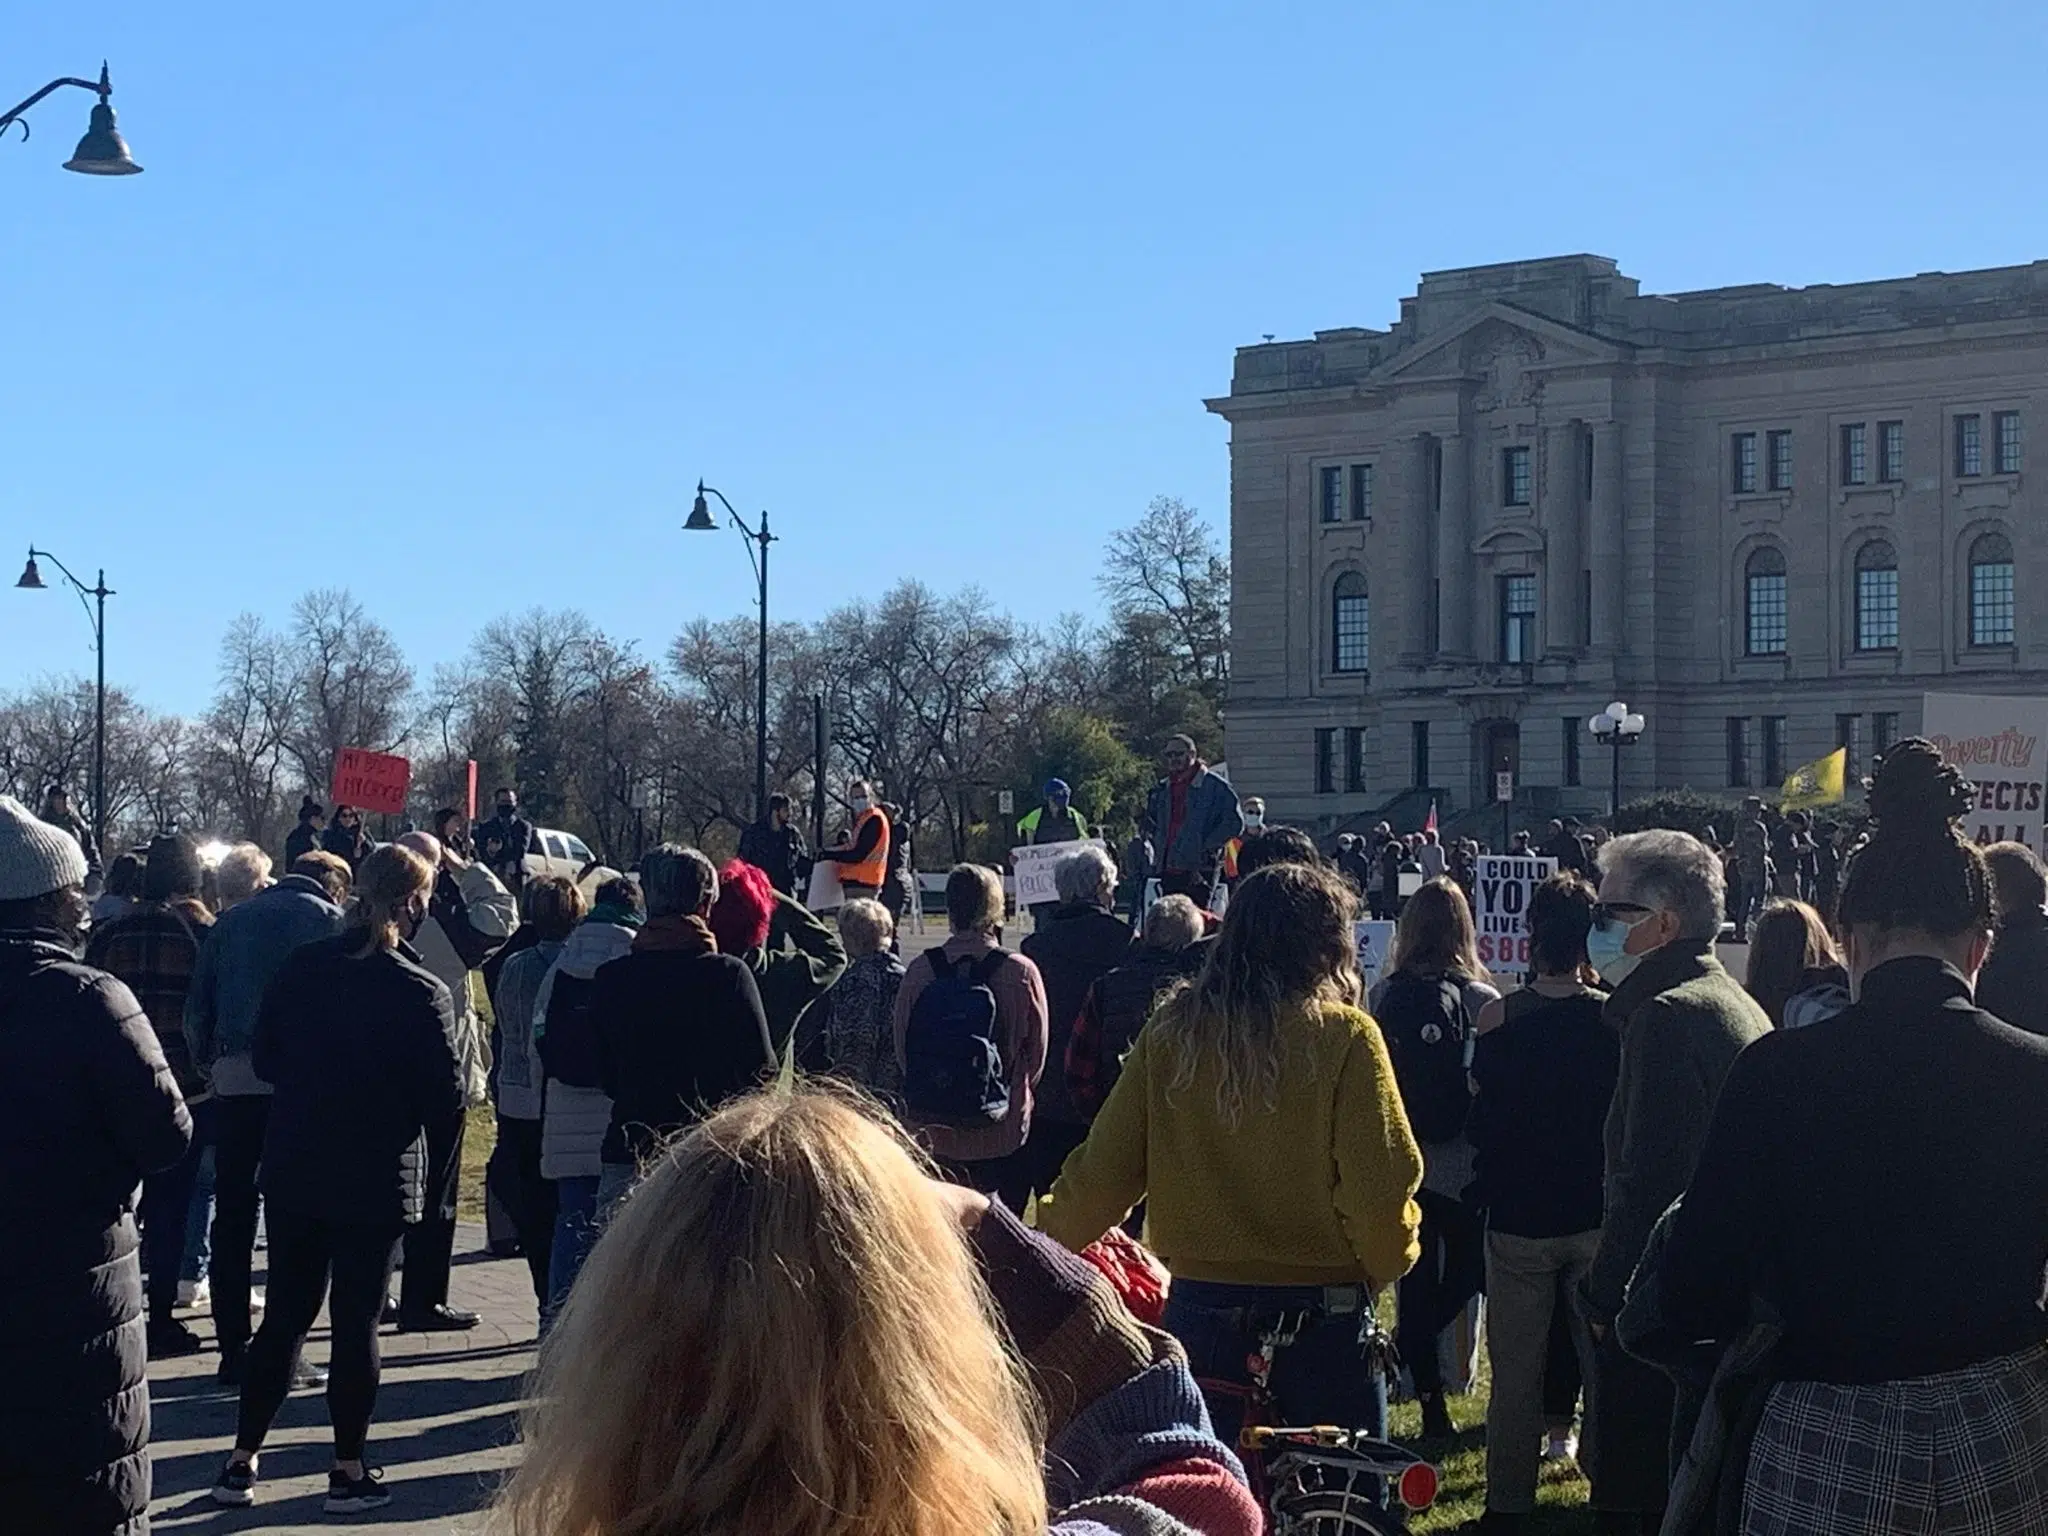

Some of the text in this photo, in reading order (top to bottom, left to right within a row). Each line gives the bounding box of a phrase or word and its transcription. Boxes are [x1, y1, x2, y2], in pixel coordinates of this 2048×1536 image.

[1931, 725, 2036, 768] Poverty
[1487, 861, 1548, 879] COULD
[1484, 916, 1519, 933] LIVE
